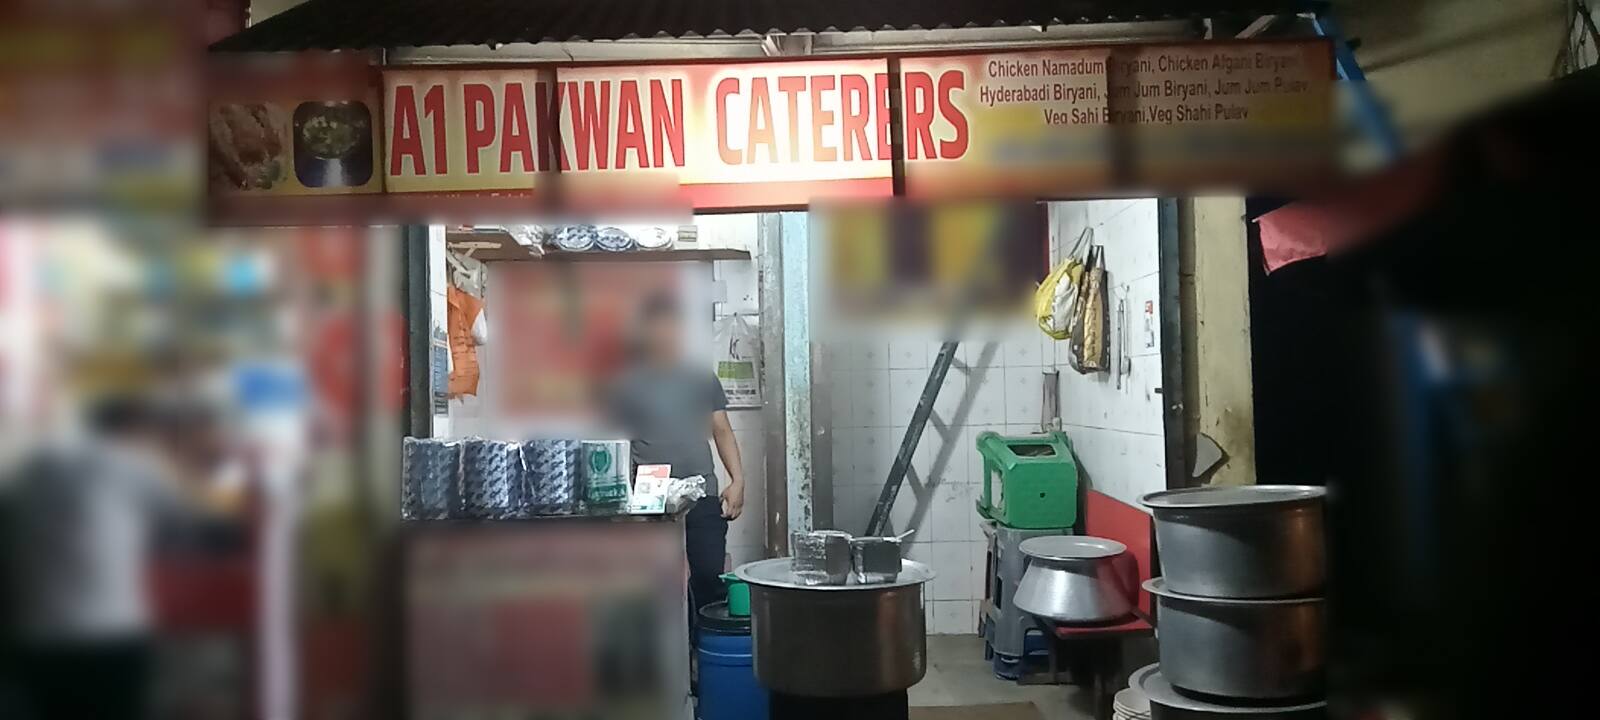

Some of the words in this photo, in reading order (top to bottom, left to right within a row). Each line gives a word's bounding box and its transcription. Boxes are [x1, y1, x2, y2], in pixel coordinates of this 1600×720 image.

[988, 60, 1038, 77] Chicken
[1042, 58, 1104, 76] Namadum
[1106, 57, 1155, 77] ryani,
[1158, 55, 1208, 72] Chicken
[980, 84, 1050, 106] Hyderabadi
[1053, 83, 1100, 104] Biryani,
[1104, 81, 1129, 98] Jm
[1134, 81, 1160, 98] Jum
[1164, 79, 1211, 101] Biryani,
[390, 84, 448, 175] A1
[463, 79, 685, 174] PAKWAN
[715, 69, 969, 165] CATERERS
[1071, 107, 1099, 124] Sahi
[1103, 104, 1172, 125] Bryani,Veg
[1176, 103, 1211, 121] Shahi
